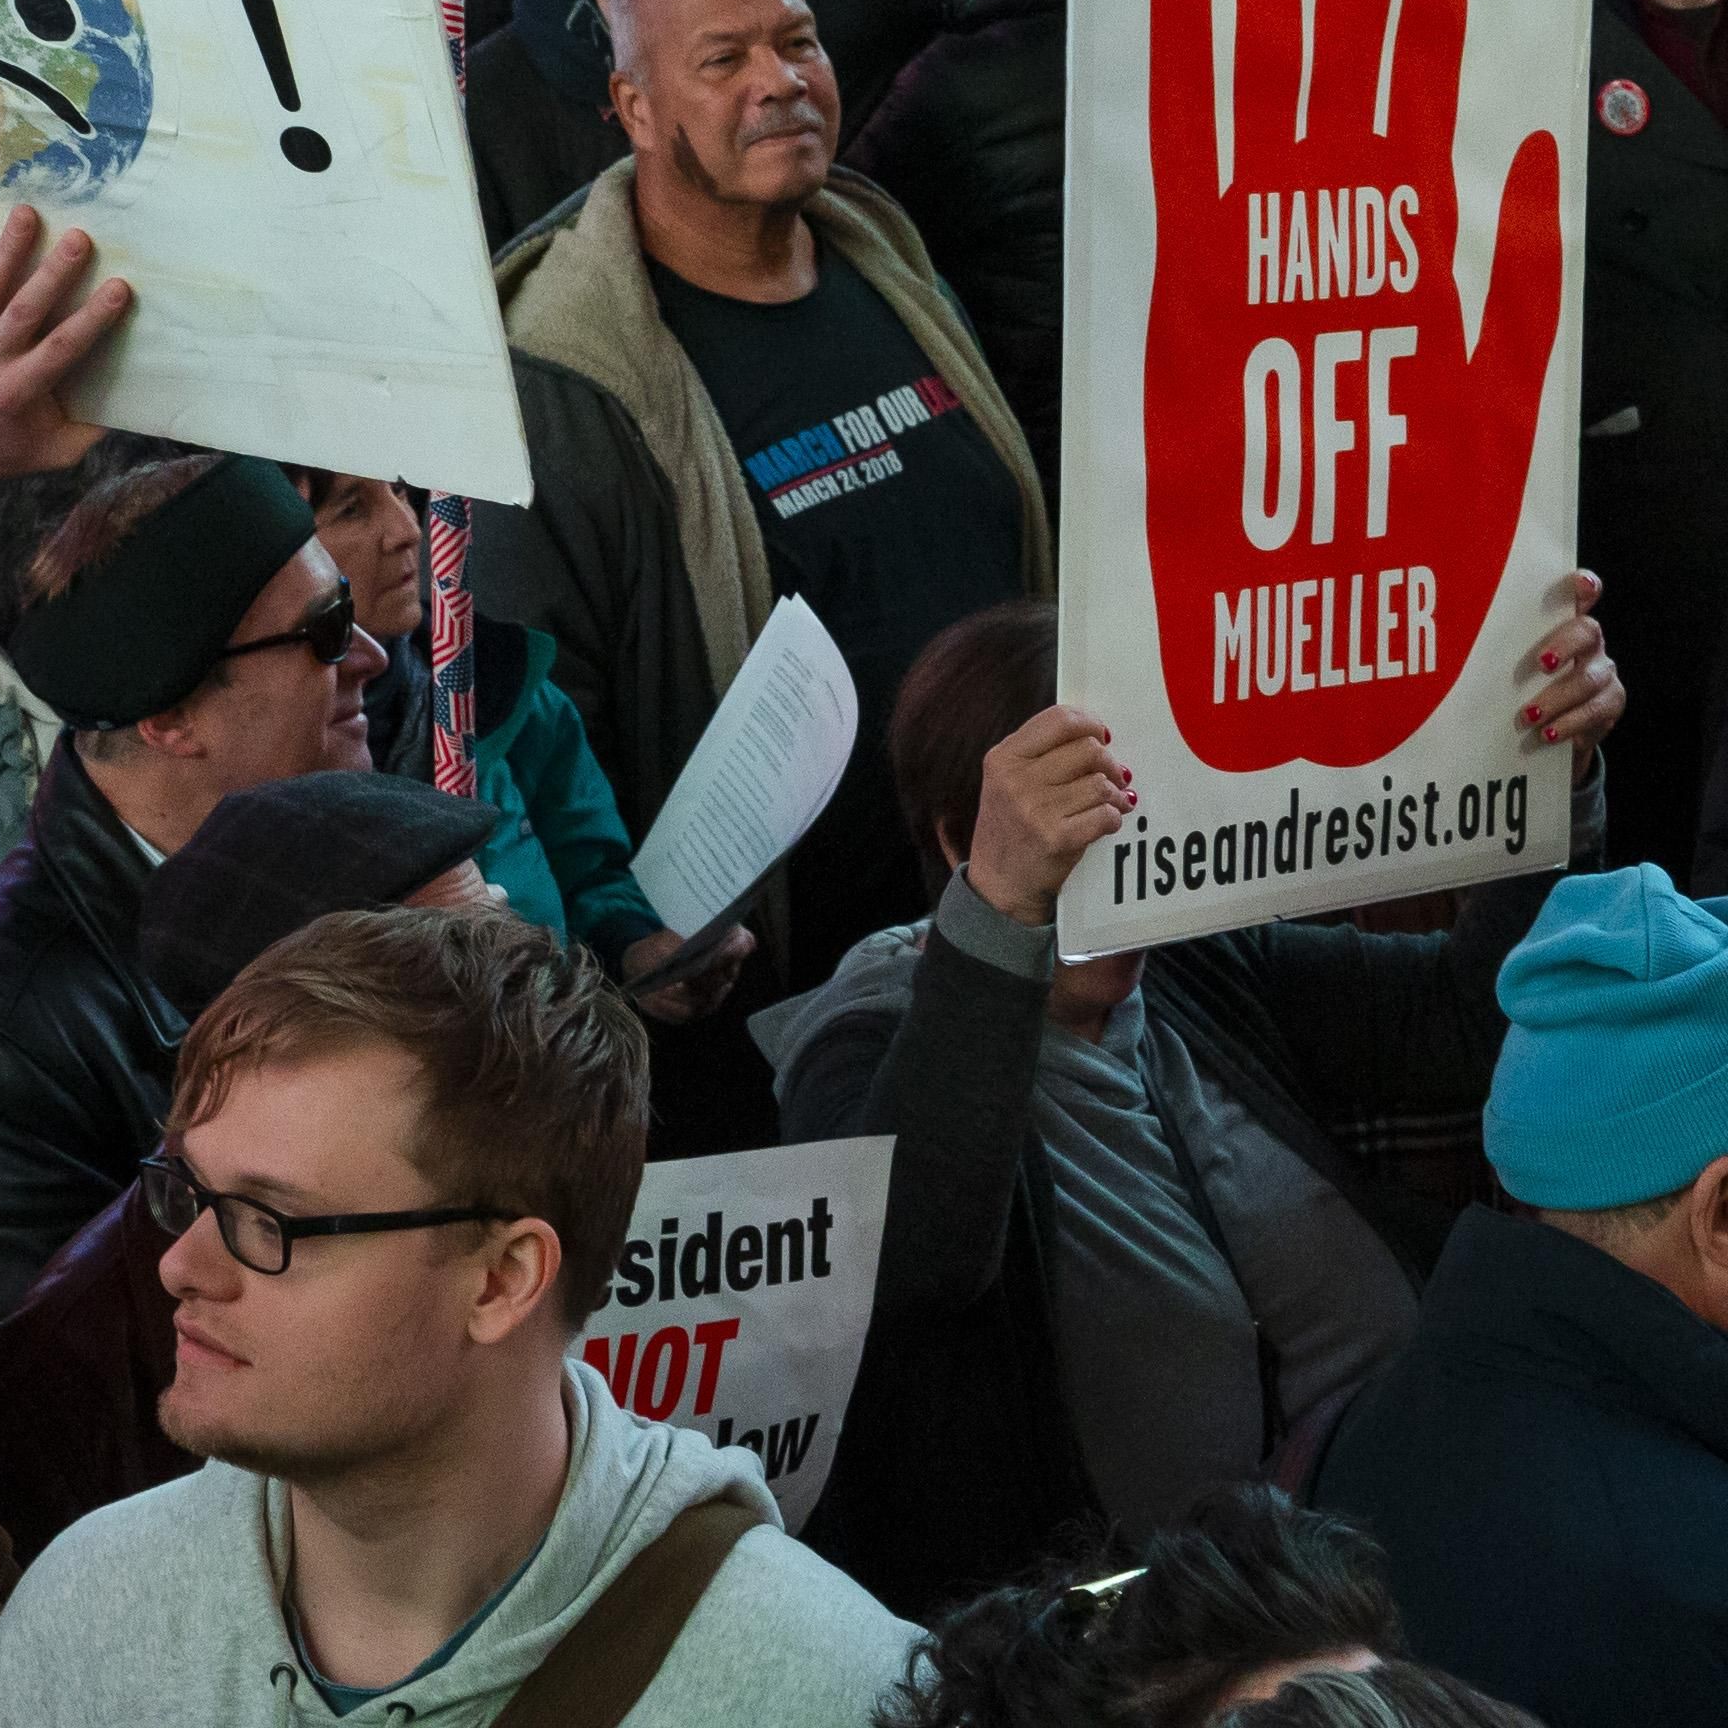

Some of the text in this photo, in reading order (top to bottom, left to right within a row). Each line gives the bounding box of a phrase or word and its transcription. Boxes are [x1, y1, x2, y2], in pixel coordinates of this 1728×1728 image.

[1247, 183, 1420, 305] HANDS
[743, 422, 847, 492] MARCH
[832, 404, 889, 455] FOR
[876, 384, 931, 435] OUR
[772, 474, 844, 520] MARCH
[858, 448, 905, 484] 2018
[1241, 325, 1419, 552] OFF
[1213, 565, 1438, 705] MUELLER
[1113, 773, 1529, 905] riseandresist.org
[597, 1196, 834, 1312] sident
[581, 1316, 741, 1422] NOT
